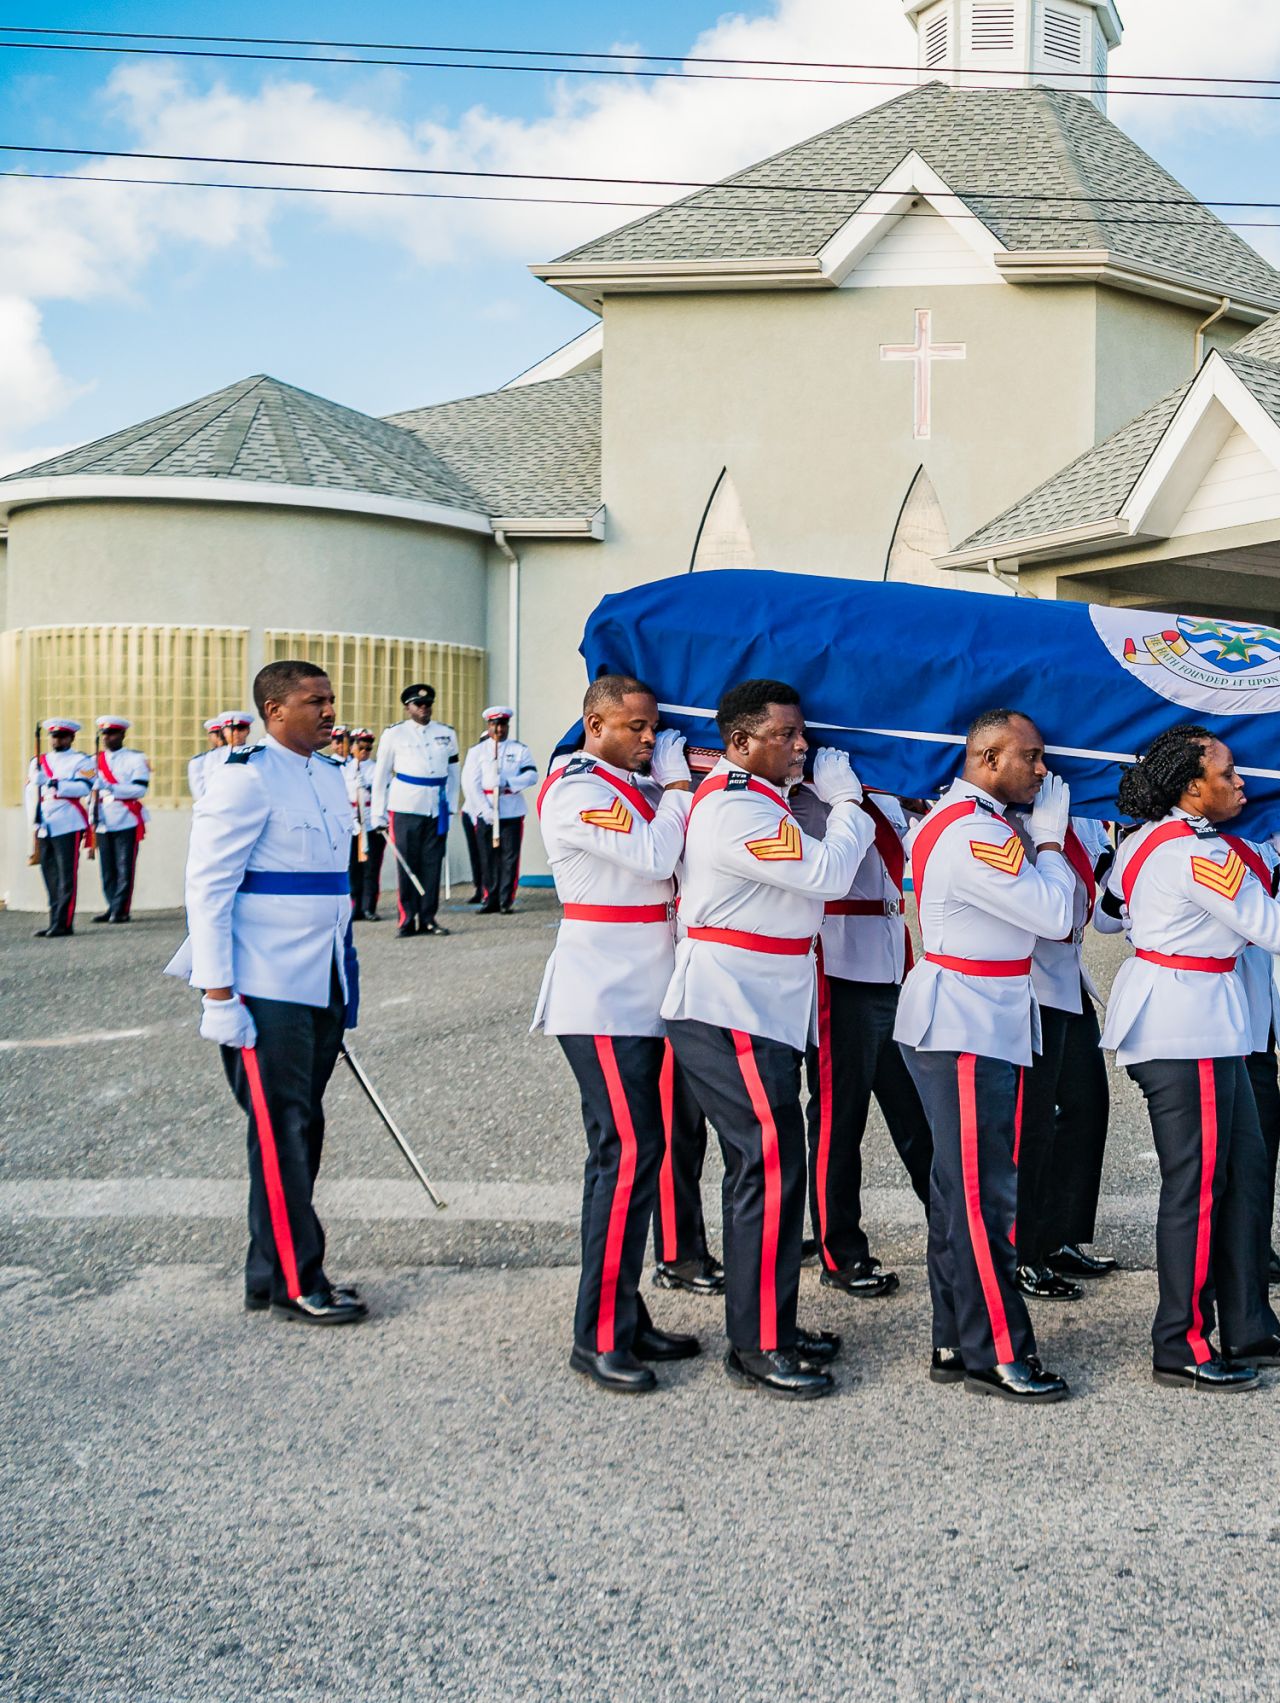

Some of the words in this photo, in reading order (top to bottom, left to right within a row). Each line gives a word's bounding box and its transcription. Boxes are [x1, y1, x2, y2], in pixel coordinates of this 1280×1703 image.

[1157, 647, 1180, 667] HATH
[1179, 665, 1229, 685] FOUNDED
[1248, 676, 1279, 686] UPON
